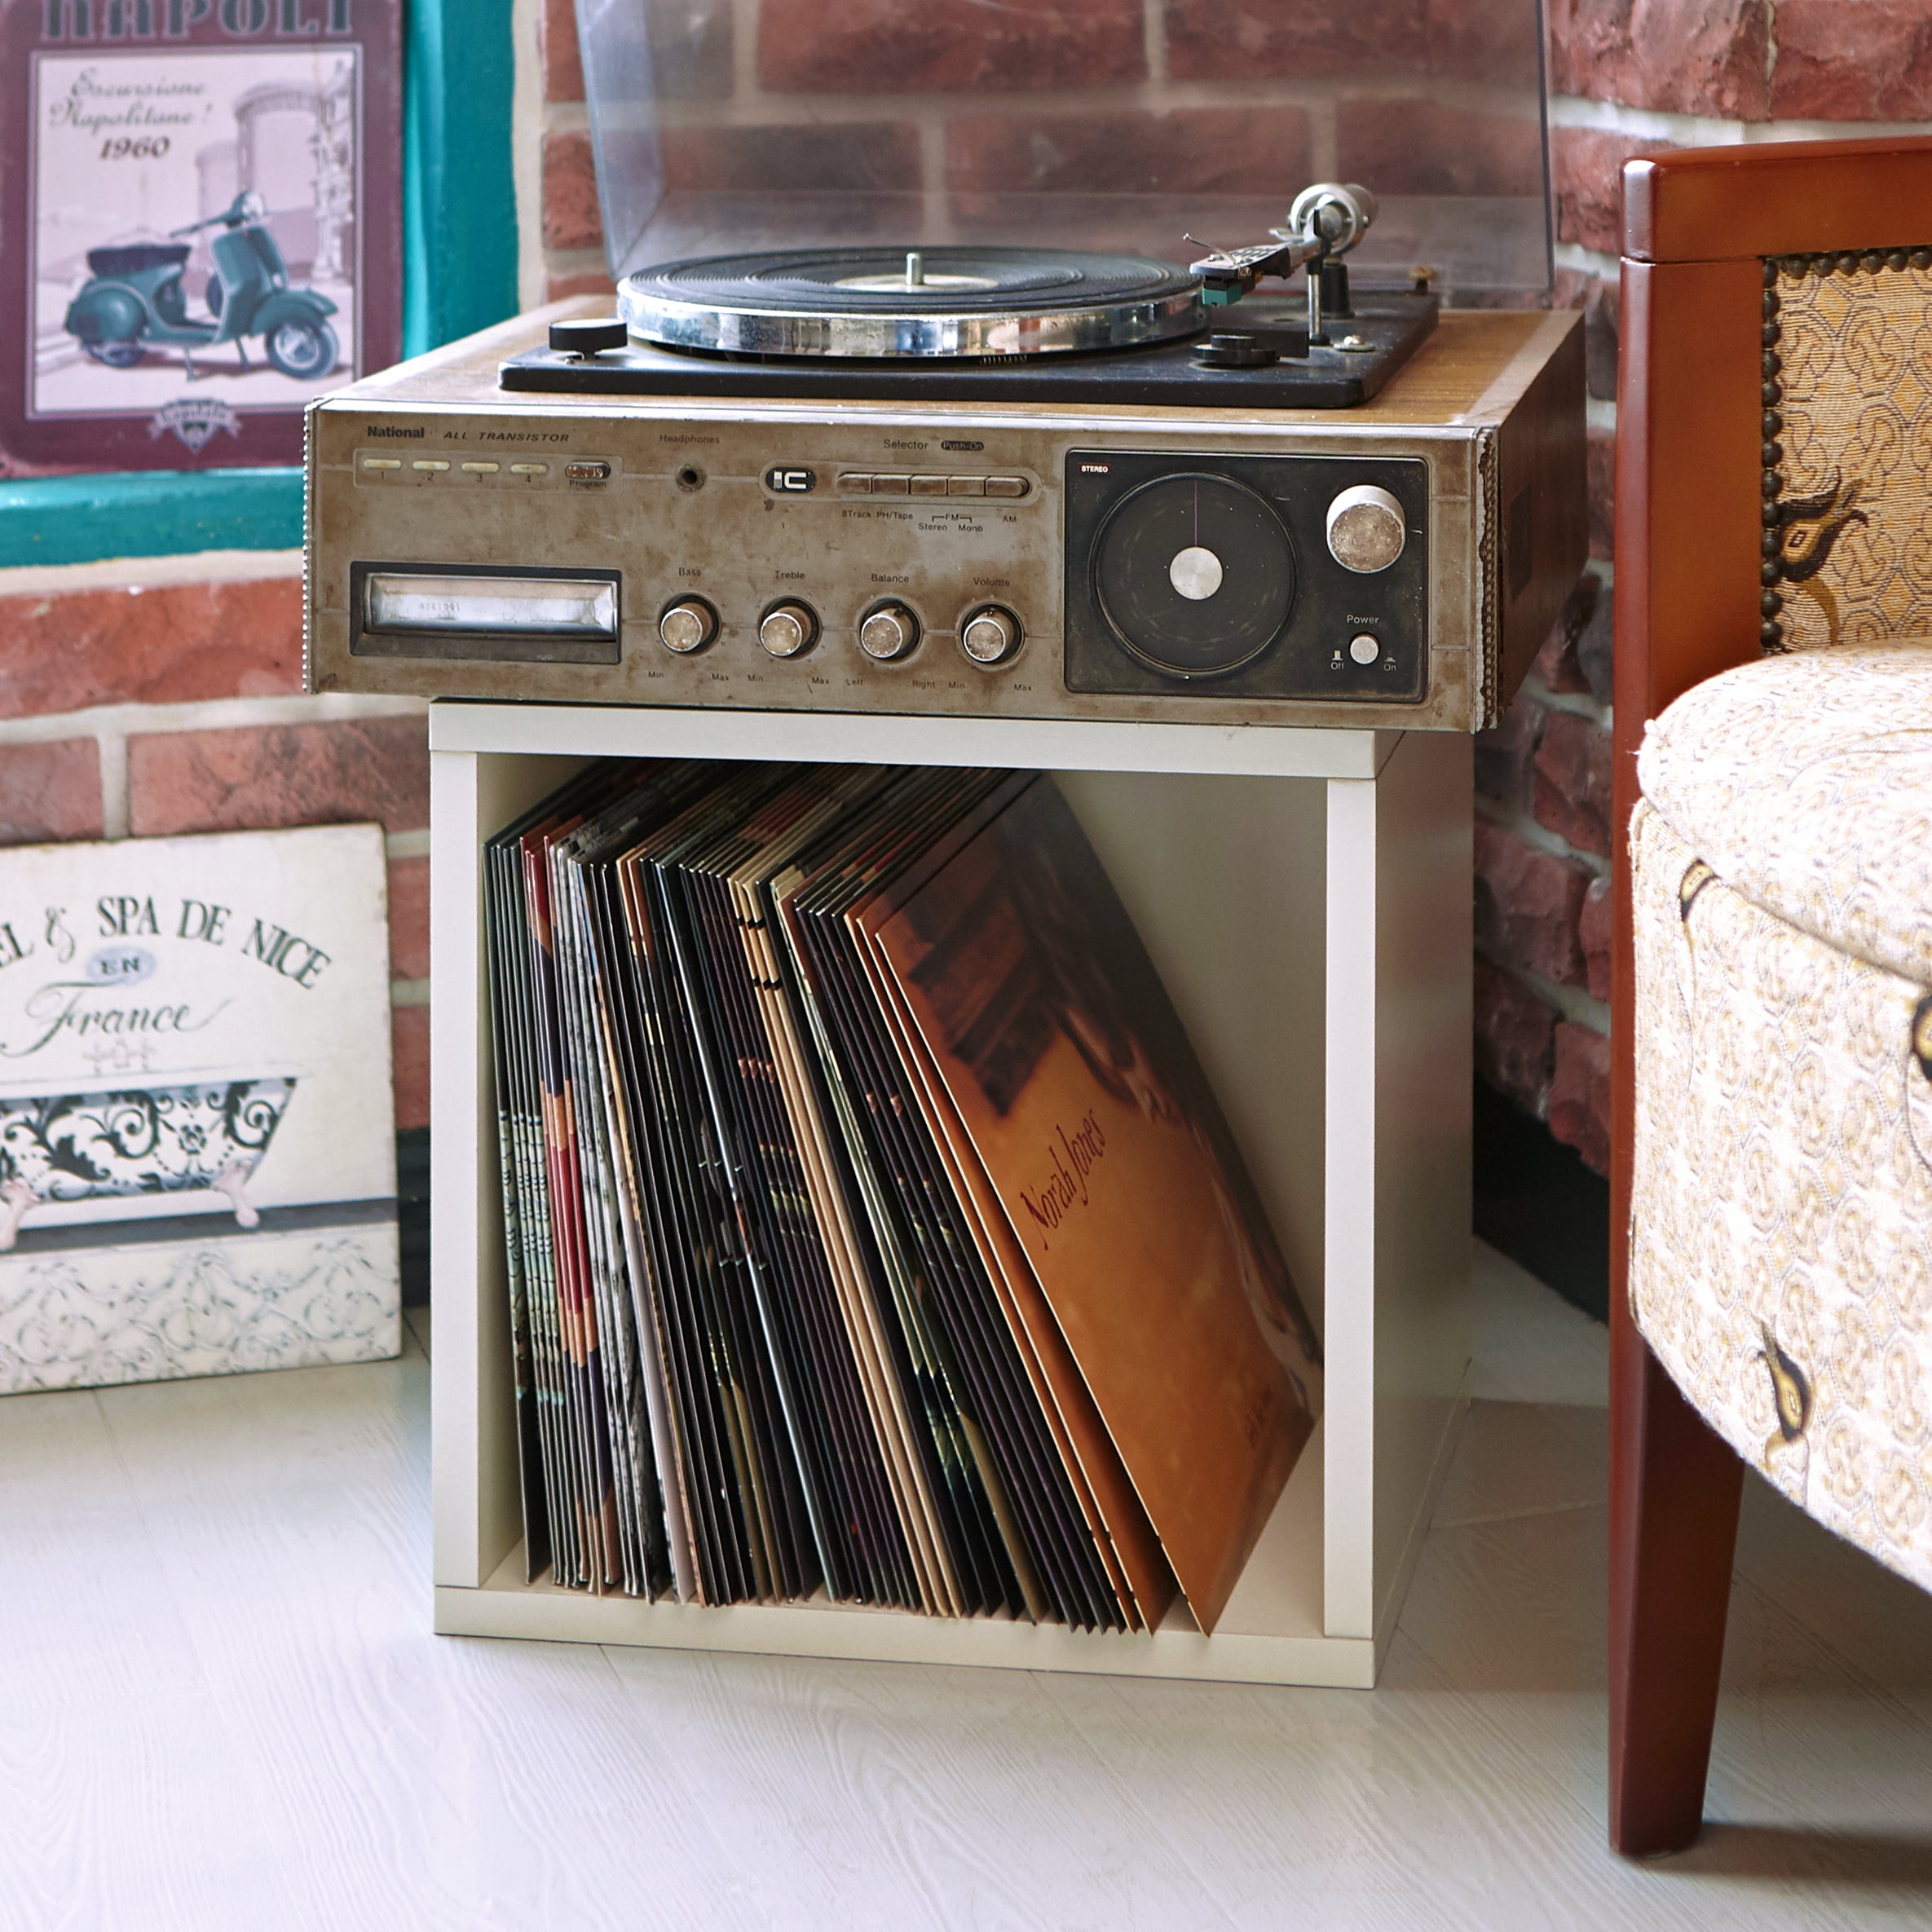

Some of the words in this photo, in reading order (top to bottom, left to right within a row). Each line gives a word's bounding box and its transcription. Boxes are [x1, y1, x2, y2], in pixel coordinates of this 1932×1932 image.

[99, 135, 171, 160] 1960
[367, 426, 425, 439] National
[443, 431, 469, 440] ALL
[479, 432, 569, 442] TRANSISTOR
[659, 434, 721, 444] Headphones
[883, 439, 929, 451] Selector
[943, 441, 983, 450] Push-On
[1081, 465, 1109, 474] STEREO
[379, 470, 386, 480] 1
[426, 472, 434, 482] 2
[476, 473, 483, 483] 3
[525, 474, 532, 483] 4
[569, 479, 607, 489] Program
[773, 471, 807, 490] IC
[876, 512, 914, 521] PH/Tape
[945, 514, 960, 522] FM
[1002, 515, 1017, 523] AM
[918, 523, 948, 532] Stereo
[958, 524, 984, 532] Mono
[678, 567, 702, 577] Bass
[774, 570, 805, 580] Treble
[871, 573, 910, 584] Balance
[973, 576, 1012, 587] Volume
[1347, 614, 1379, 624] Power
[1330, 662, 1344, 670] Off
[1383, 664, 1396, 672] On
[648, 671, 664, 679] Min
[712, 673, 730, 681] Max
[748, 675, 764, 683] Min
[812, 677, 830, 686] Max
[912, 680, 936, 690] Right
[948, 681, 965, 690] Min
[1014, 684, 1033, 692] Max
[96, 896, 162, 937] SPA
[177, 899, 232, 946] DE
[241, 919, 332, 990] NICE
[100, 957, 141, 975] EN
[0, 980, 236, 1059] France
[1020, 1145, 1077, 1251] Norah
[1055, 1108, 1106, 1207] Jones
